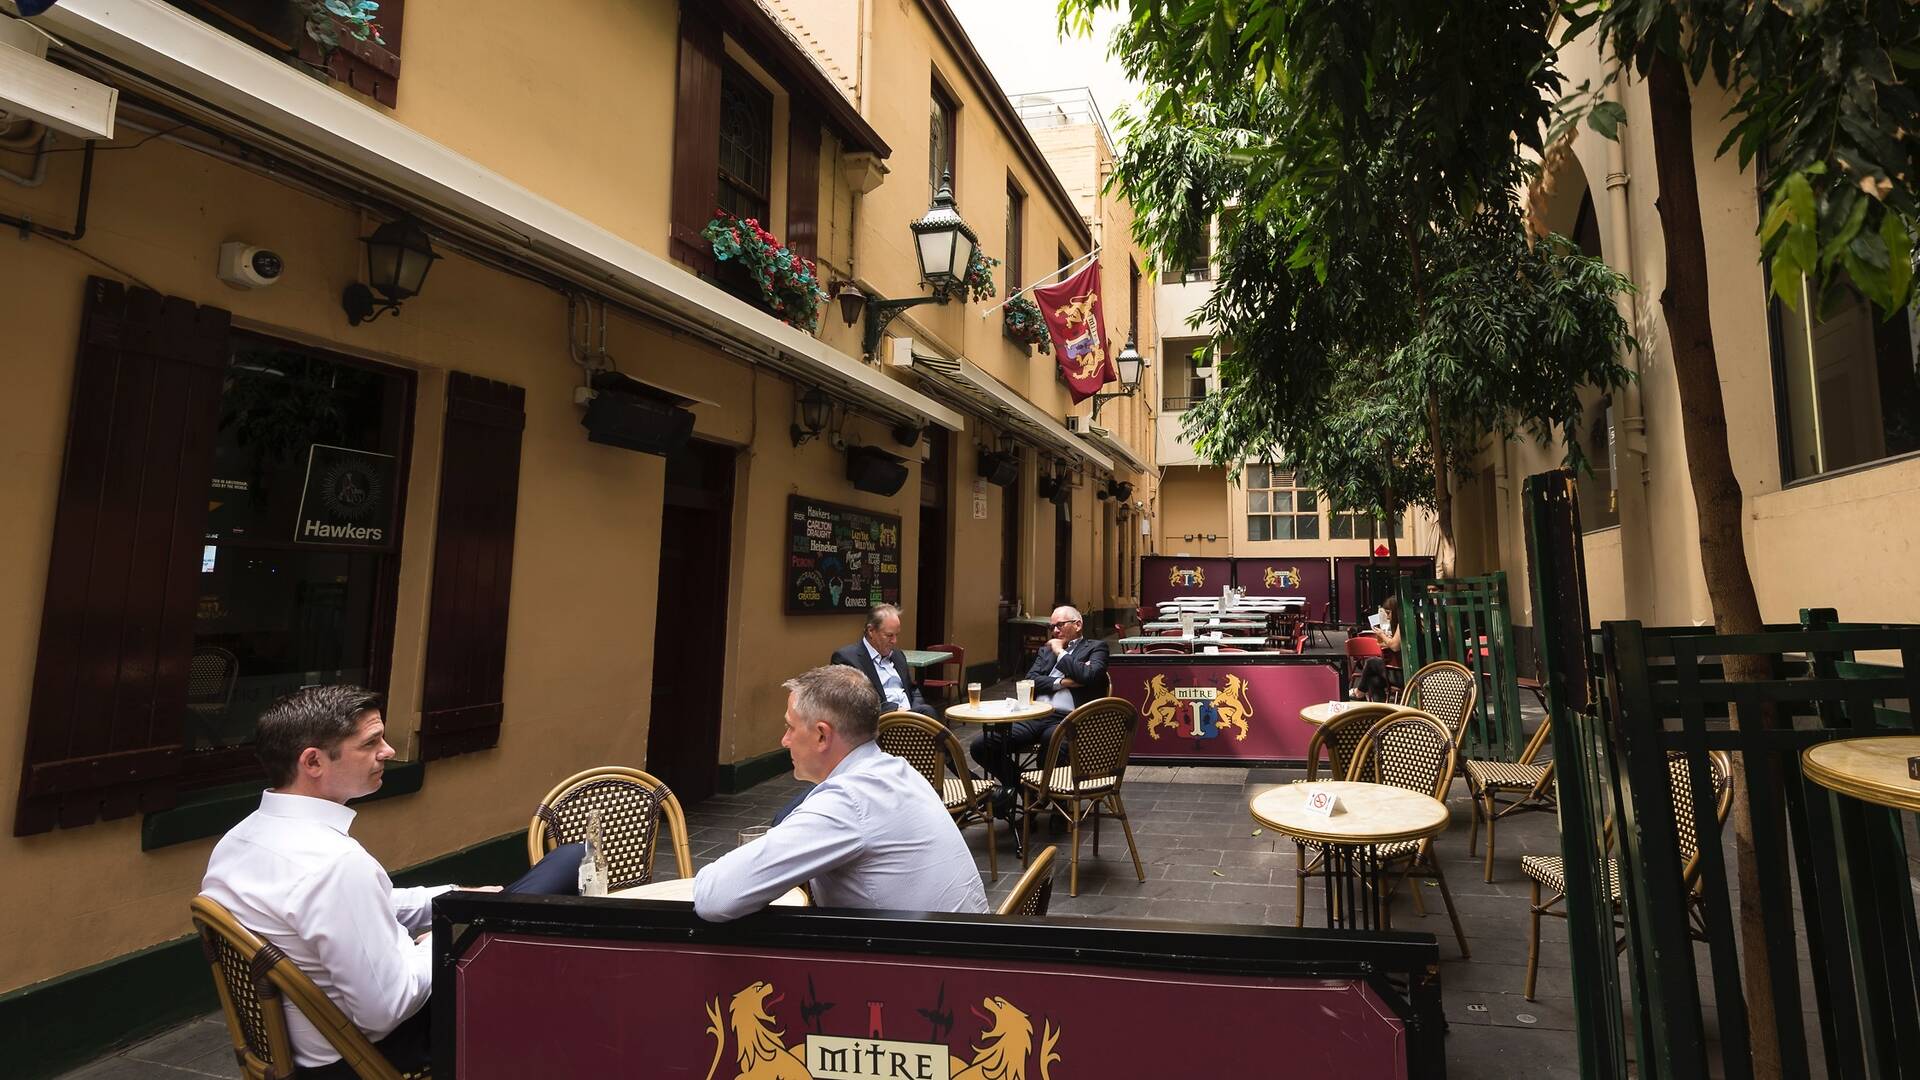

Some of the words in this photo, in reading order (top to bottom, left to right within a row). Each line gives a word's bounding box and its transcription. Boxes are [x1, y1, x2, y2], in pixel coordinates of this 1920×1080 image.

[807, 505, 831, 520] Hawkers
[304, 520, 383, 540] Hawkers
[806, 520, 832, 531] CARLTON
[806, 528, 832, 539] DRAUGHT
[810, 540, 838, 553] Heineken
[845, 597, 867, 607] GUINNESS
